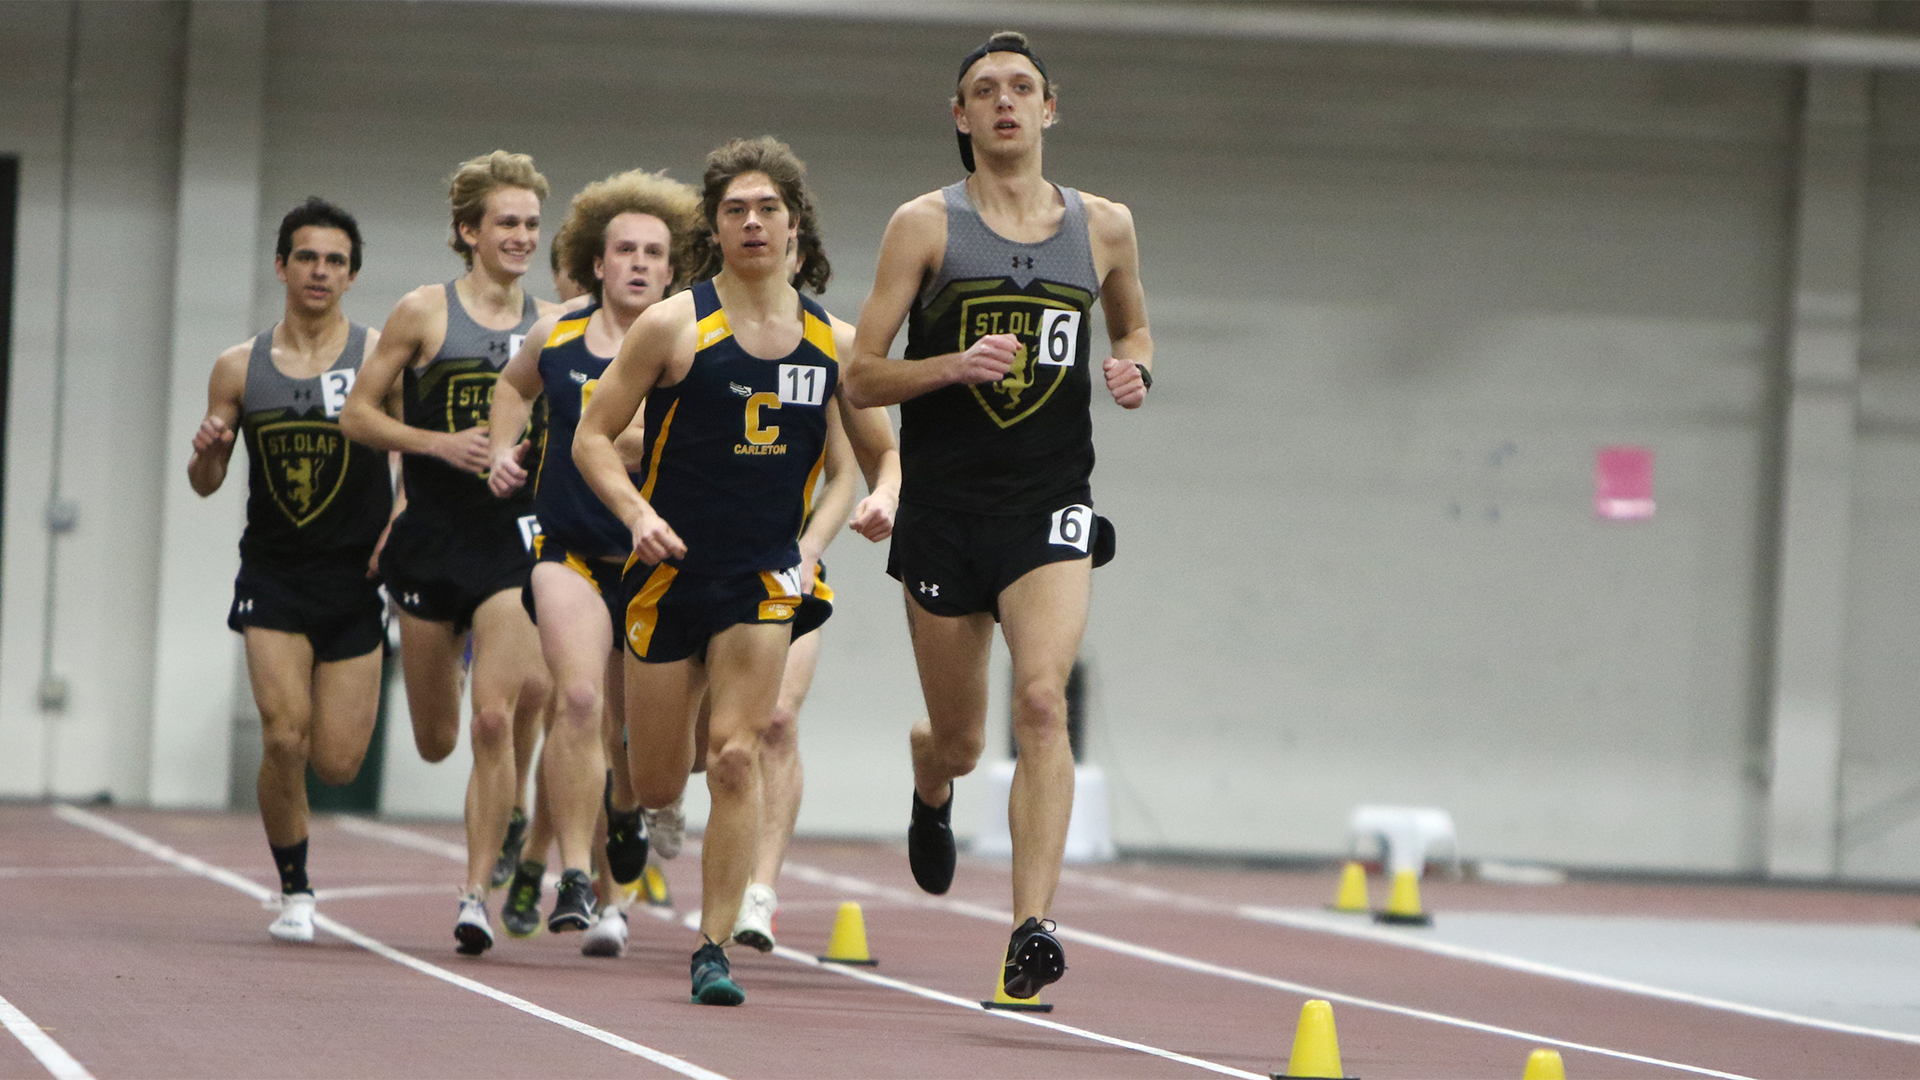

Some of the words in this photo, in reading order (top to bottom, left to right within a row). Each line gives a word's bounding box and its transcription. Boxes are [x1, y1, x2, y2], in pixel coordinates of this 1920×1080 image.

[975, 312, 1004, 336] ST.
[1048, 313, 1071, 363] 6
[329, 373, 348, 412] 3
[459, 385, 483, 406] ST.
[787, 367, 815, 402] 11
[745, 392, 782, 445] C
[268, 435, 292, 455] ST.
[294, 433, 338, 454] OLAF
[734, 444, 787, 455] CARLETON
[1059, 507, 1083, 544] 6
